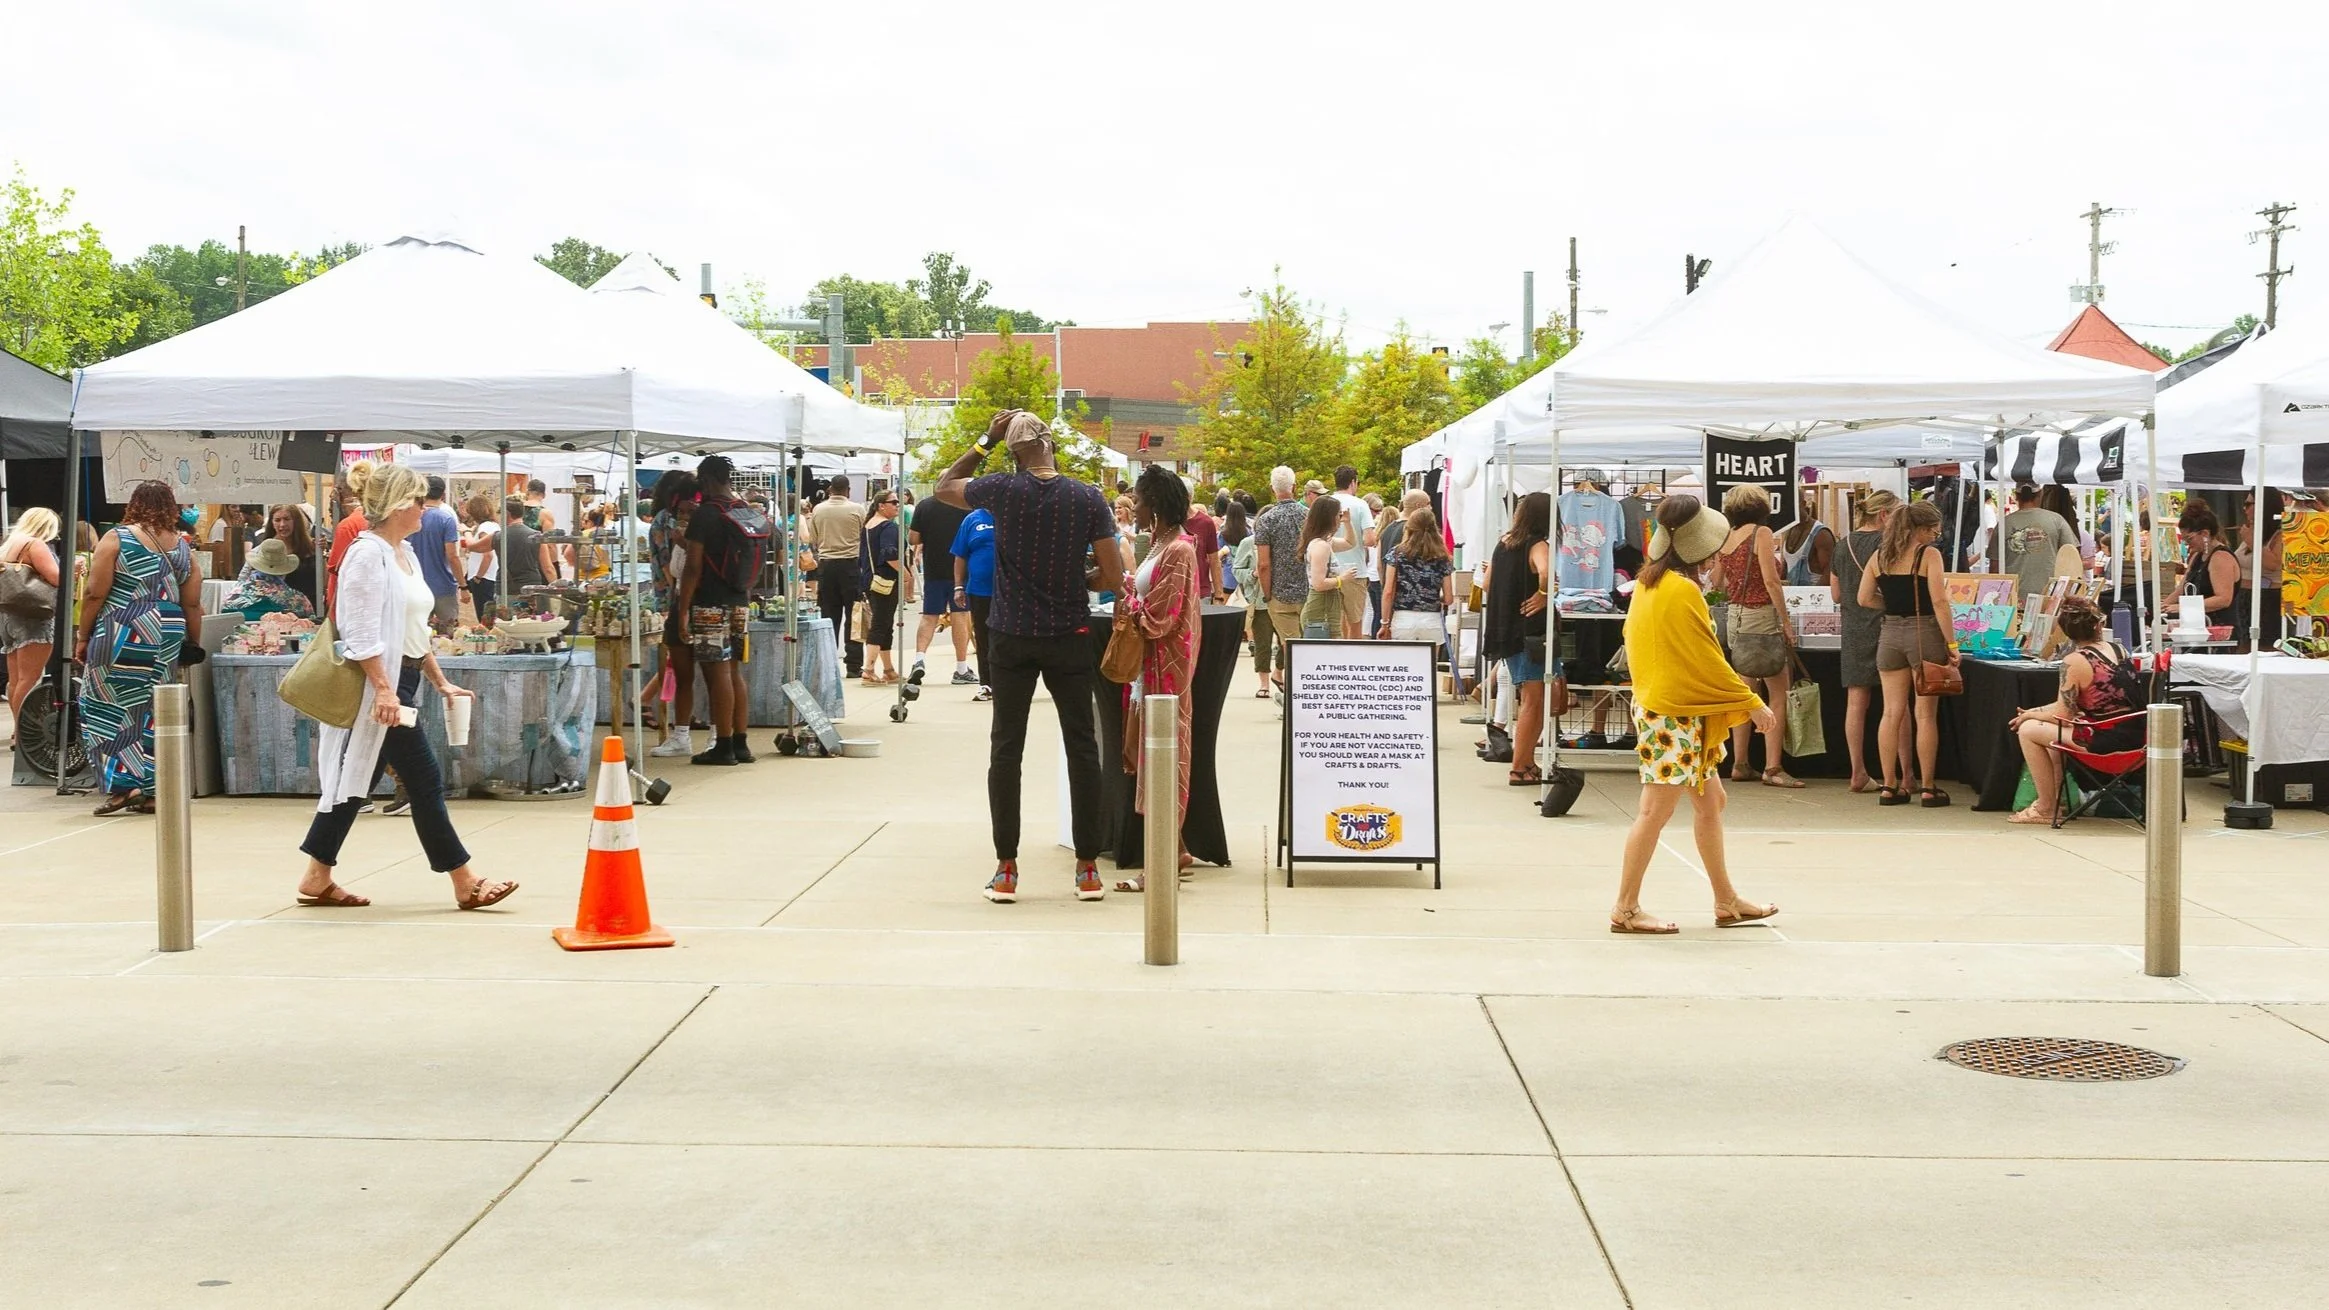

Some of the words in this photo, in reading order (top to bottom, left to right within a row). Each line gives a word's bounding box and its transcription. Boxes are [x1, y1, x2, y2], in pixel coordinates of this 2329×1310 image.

[253, 442, 280, 461] LEW
[1715, 452, 1788, 477] HEART
[1328, 664, 1347, 672] THIS
[1379, 684, 1403, 692] (CDC)
[1377, 694, 1432, 702] DEPARTMENT
[1339, 812, 1388, 823] CRAFTS
